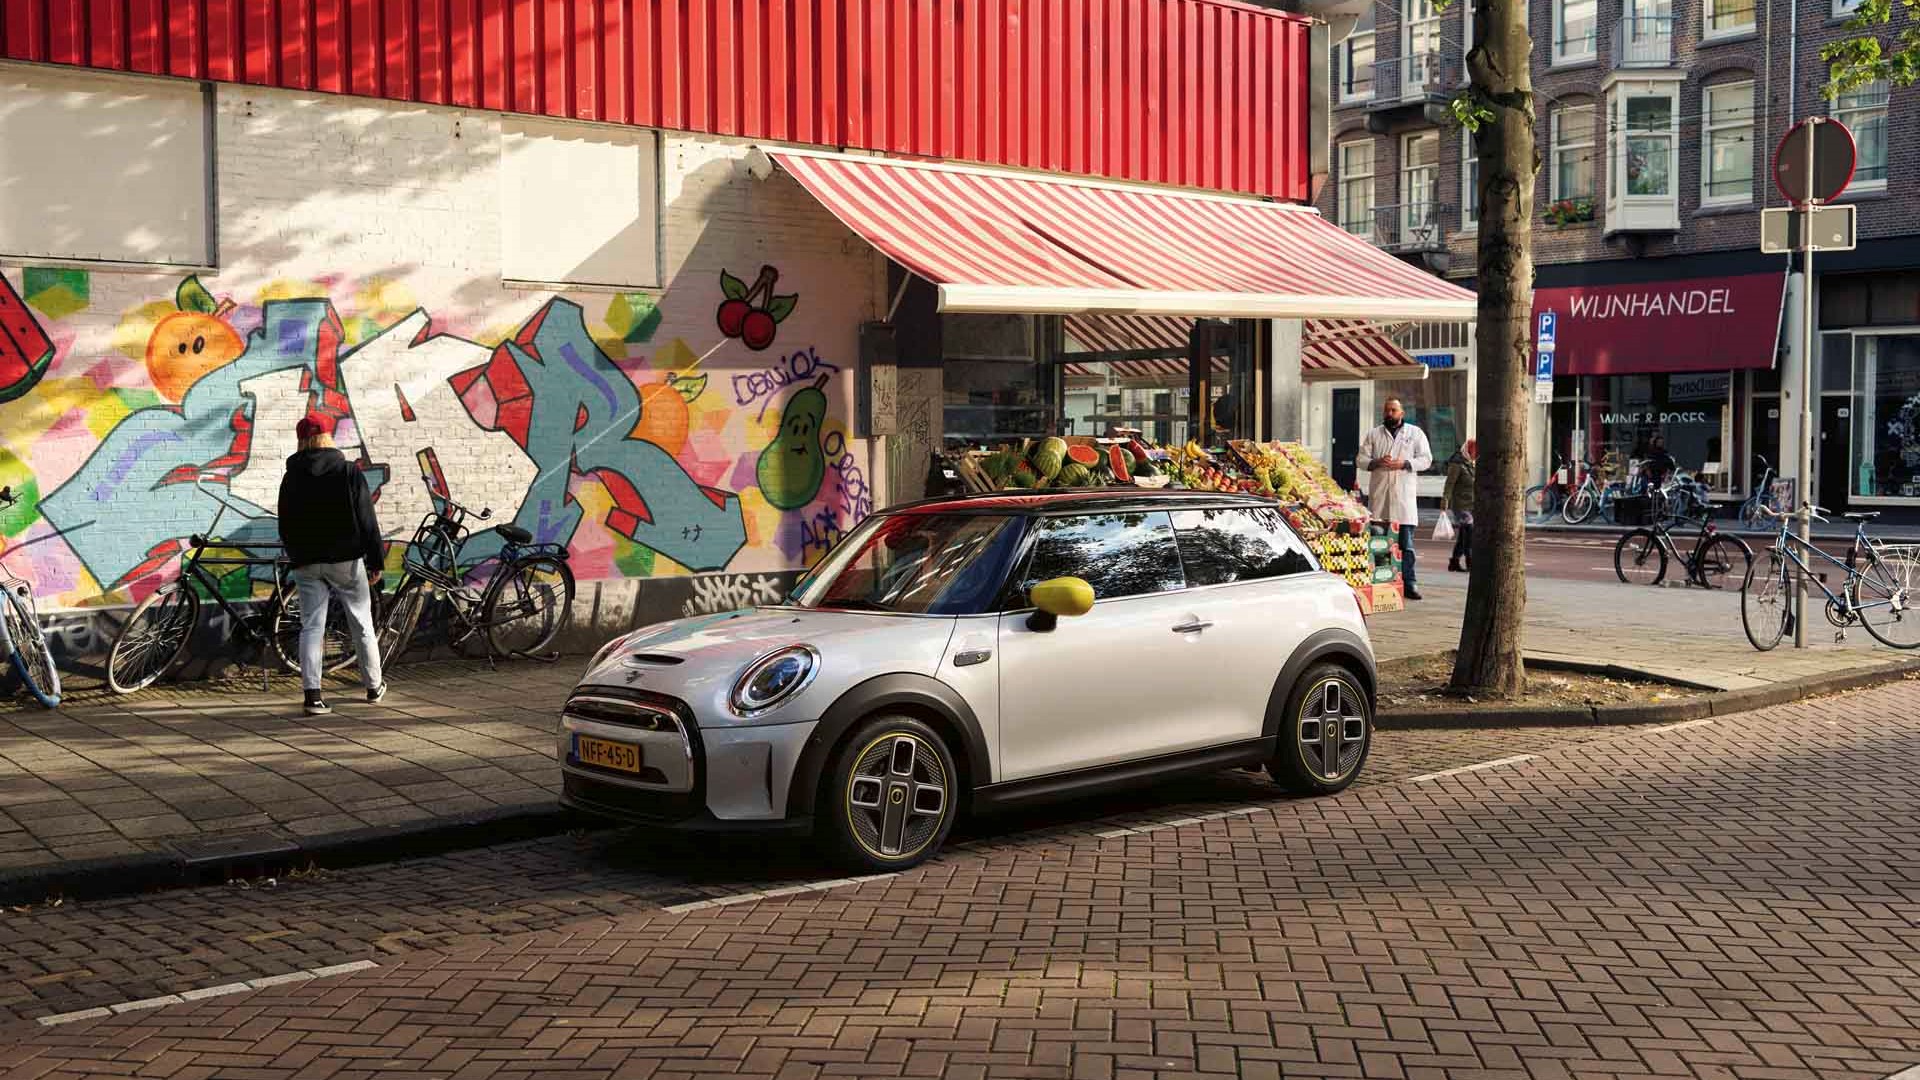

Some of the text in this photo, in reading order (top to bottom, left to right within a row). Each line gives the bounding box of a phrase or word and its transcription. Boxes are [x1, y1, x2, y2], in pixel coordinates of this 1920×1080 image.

[1570, 289, 1735, 318] WIJNHANDEL
[1542, 315, 1552, 331] P
[1540, 354, 1549, 370] P
[1600, 412, 1640, 424] WINE
[1660, 411, 1705, 423] ROSES
